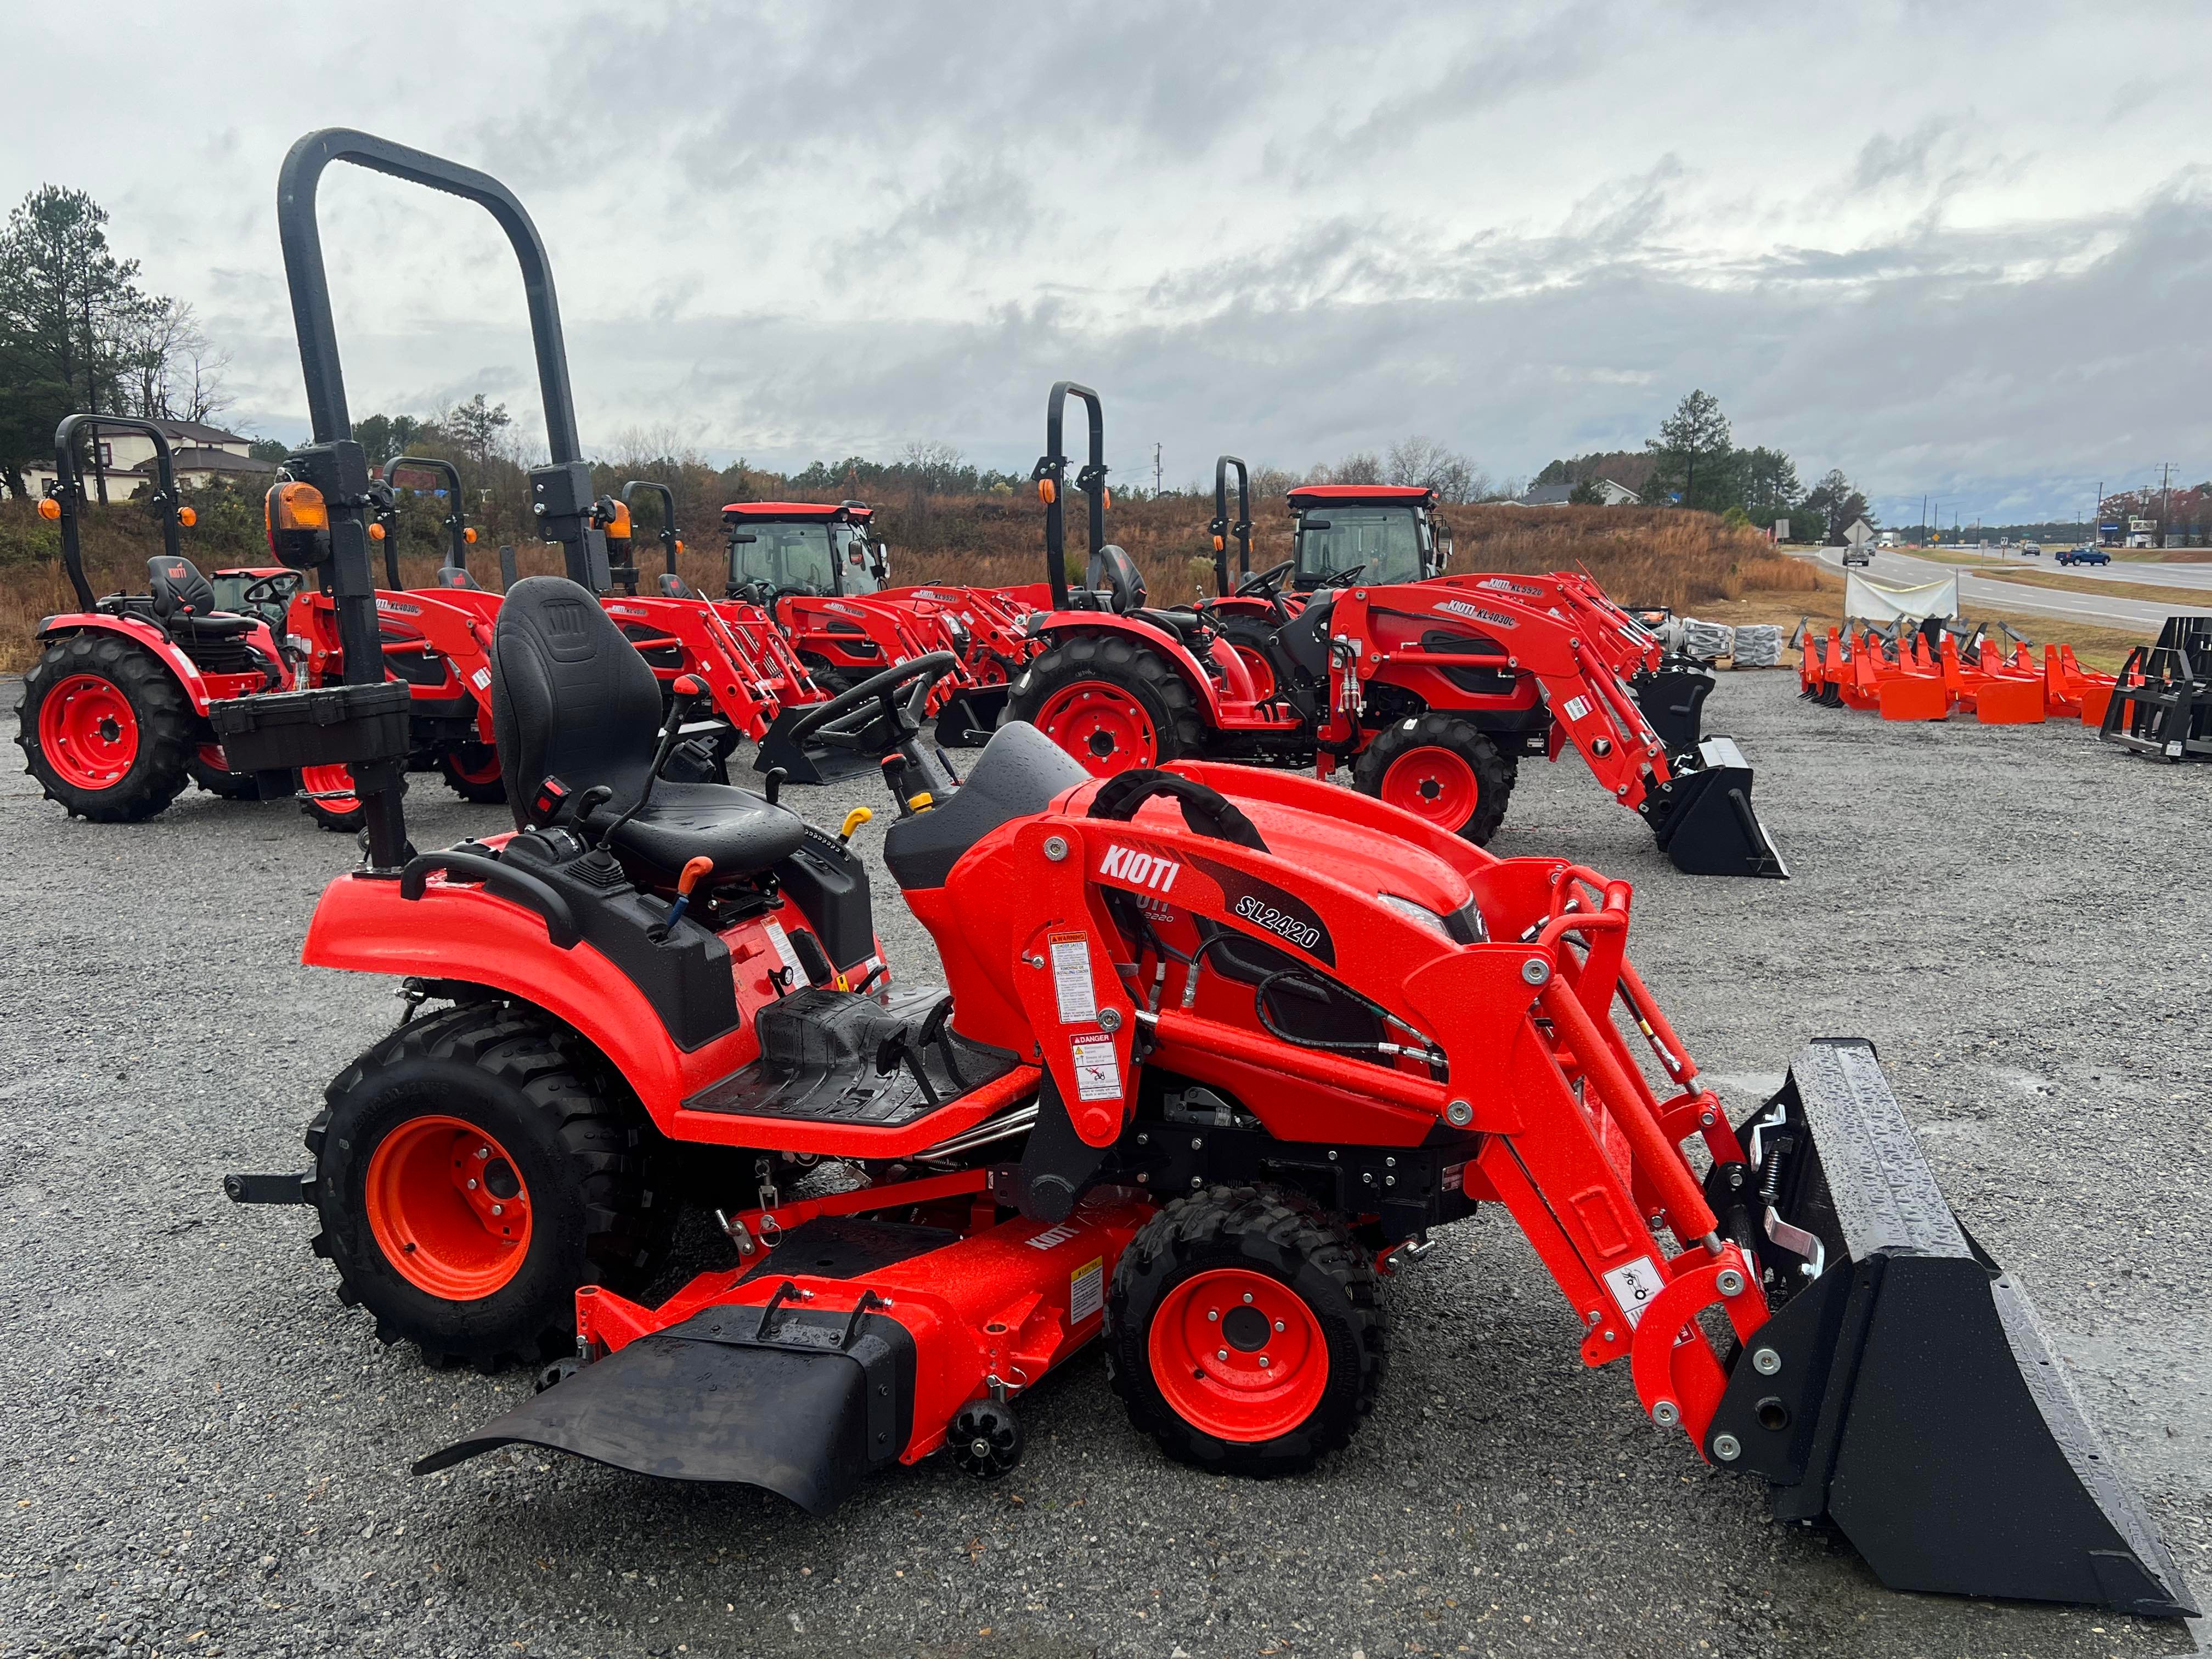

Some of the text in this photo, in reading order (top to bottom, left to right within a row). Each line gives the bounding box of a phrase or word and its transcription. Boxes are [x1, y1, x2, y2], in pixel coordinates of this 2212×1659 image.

[1488, 578, 1510, 589] KIOTI
[390, 601, 419, 613] KL4030C
[612, 605, 625, 613] KIOTI
[831, 602, 844, 611] KIOTI
[1447, 599, 1515, 626] KIOTI KL4030C
[1099, 844, 1180, 893] KIOTI
[1235, 895, 1320, 948] SL2420
[1080, 1034, 1109, 1043] DANGER
[1024, 1222, 1080, 1250] KIOTI
